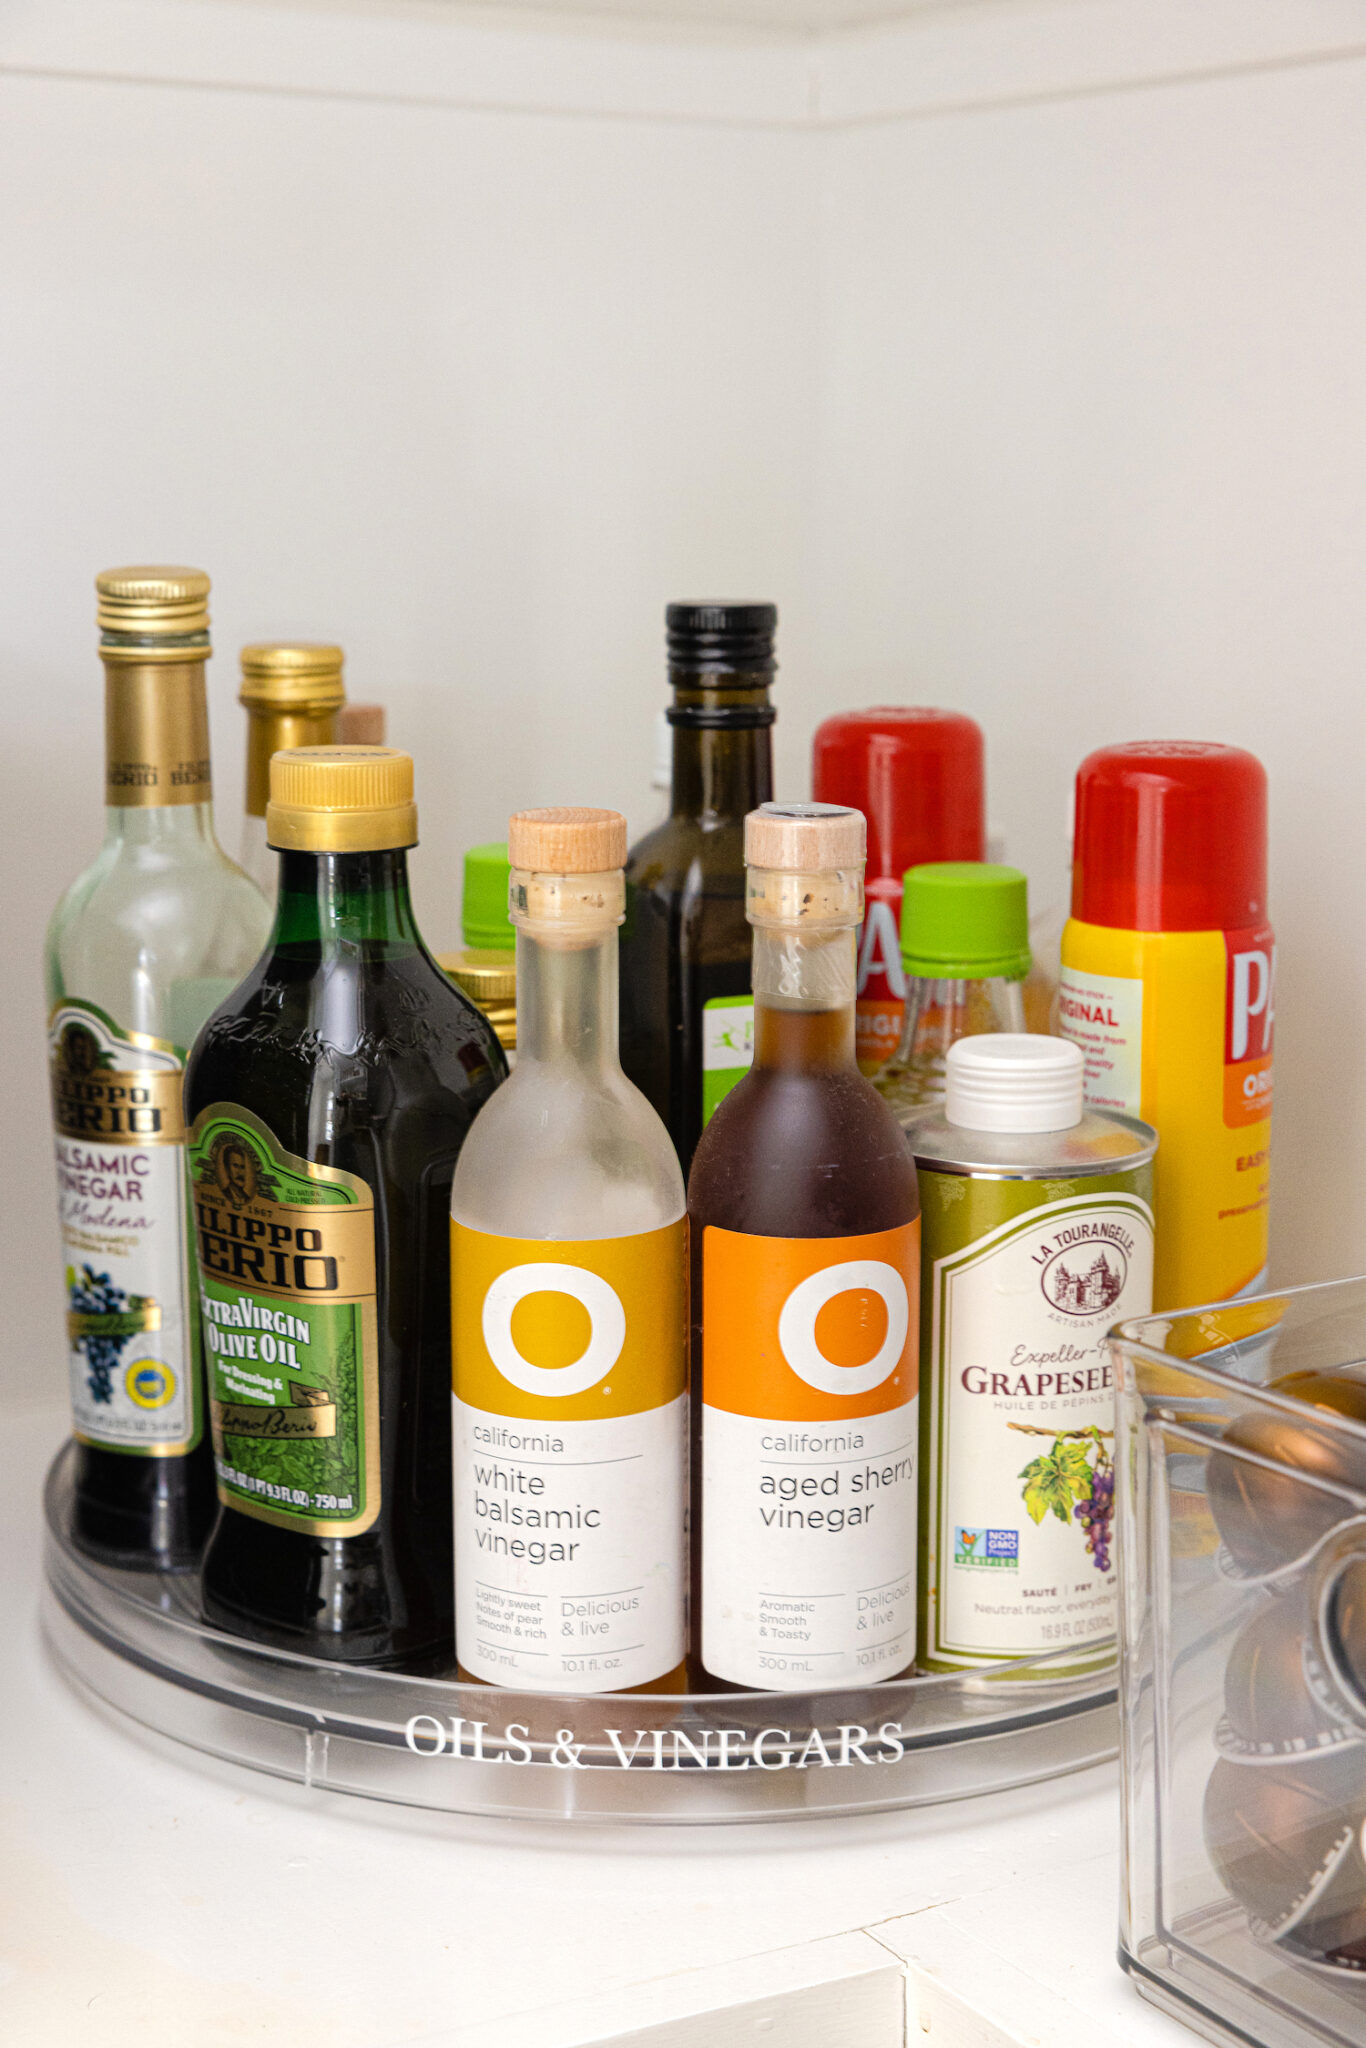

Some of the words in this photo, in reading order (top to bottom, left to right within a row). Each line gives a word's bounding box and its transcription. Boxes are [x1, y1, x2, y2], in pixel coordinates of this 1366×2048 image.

[1103, 1034, 1127, 1045] from
[57, 1098, 162, 1133] ERIO
[62, 1173, 143, 1201] NEGAR
[197, 1203, 323, 1252] ILIPPO
[1031, 1244, 1054, 1266] LA
[1053, 1222, 1136, 1253] TOURANGELLE
[200, 1229, 339, 1290] ERIO
[482, 1262, 626, 1397] O
[778, 1260, 909, 1395] O
[1047, 1312, 1094, 1329] ARTISAN
[208, 1322, 258, 1360] OLIVE
[259, 1333, 302, 1371] OIL
[1011, 1336, 1110, 1369] Expeller-P
[274, 1377, 283, 1391] &
[960, 1364, 1113, 1397] GRAPESEE
[993, 1400, 1035, 1411] HUILE
[1040, 1400, 1058, 1410] DE
[473, 1424, 565, 1454] california
[760, 1431, 865, 1453] california
[473, 1463, 546, 1497] white
[759, 1470, 840, 1501] aged
[851, 1456, 914, 1493] sherry
[315, 1493, 337, 1510] 750
[337, 1494, 353, 1510] ml
[474, 1490, 602, 1529] balsamic
[759, 1503, 875, 1533] vinegar
[475, 1526, 580, 1565] vinegar
[988, 1530, 1017, 1541] NON
[988, 1540, 1018, 1550] GMO
[957, 1556, 1017, 1568] VERIFIED
[475, 1588, 506, 1608] Lightly
[508, 1598, 542, 1612] sweet
[1022, 1586, 1057, 1598] SAUTÉ
[475, 1601, 502, 1618] Notes
[503, 1611, 515, 1621] of
[517, 1614, 545, 1626] pear
[560, 1596, 640, 1618] Delicious
[758, 1599, 816, 1613] Aromatic
[974, 1602, 1024, 1616] Neutral
[476, 1614, 512, 1634] Smooth
[513, 1625, 522, 1637] &
[524, 1627, 548, 1640] rich
[560, 1621, 575, 1637] &
[580, 1619, 611, 1636] live
[759, 1612, 808, 1626] Smooth
[856, 1615, 868, 1631] &
[872, 1610, 895, 1628] live
[758, 1626, 769, 1638] &
[771, 1627, 812, 1642] Toasty
[476, 1644, 498, 1662] 300
[499, 1653, 519, 1668] mL
[561, 1659, 586, 1673] 10.1
[758, 1657, 788, 1671] 300
[791, 1658, 814, 1672] mL
[404, 1714, 533, 1766] OILS
[549, 1727, 590, 1770] &
[604, 1721, 906, 1771] VINEGARS
